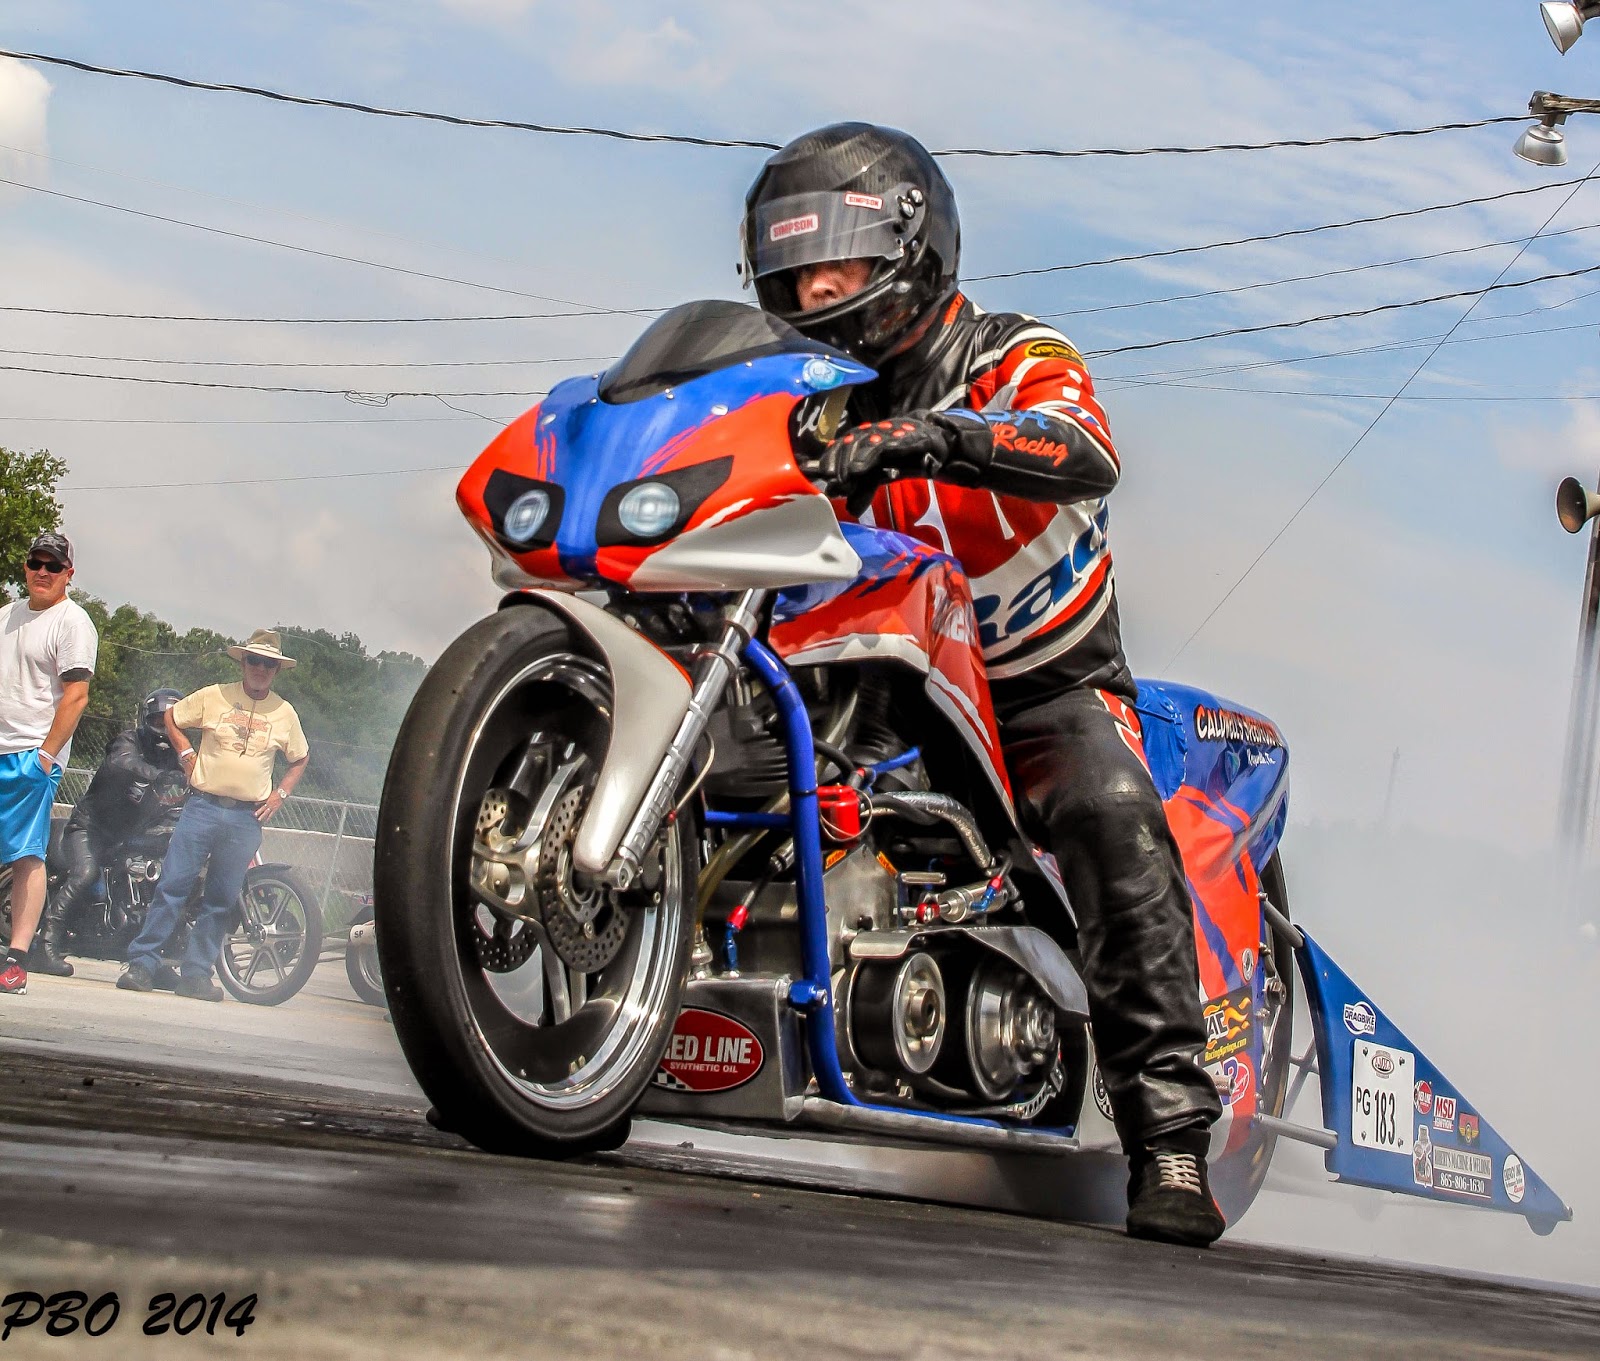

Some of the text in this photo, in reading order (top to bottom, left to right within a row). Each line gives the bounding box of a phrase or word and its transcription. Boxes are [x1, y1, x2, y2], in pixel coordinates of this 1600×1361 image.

[850, 196, 879, 207] SIMPSON
[773, 217, 814, 238] SIMPSON
[991, 421, 1069, 467] Racing
[1344, 1010, 1375, 1026] DRAGBIKE
[664, 1034, 753, 1064] ED LINE
[670, 1061, 738, 1074] SYNTHETIC OIL
[1355, 1086, 1371, 1116] PG
[1436, 1097, 1454, 1119] MSD
[1374, 1089, 1396, 1145] 183
[1440, 1172, 1485, 1194] 865-806-1630
